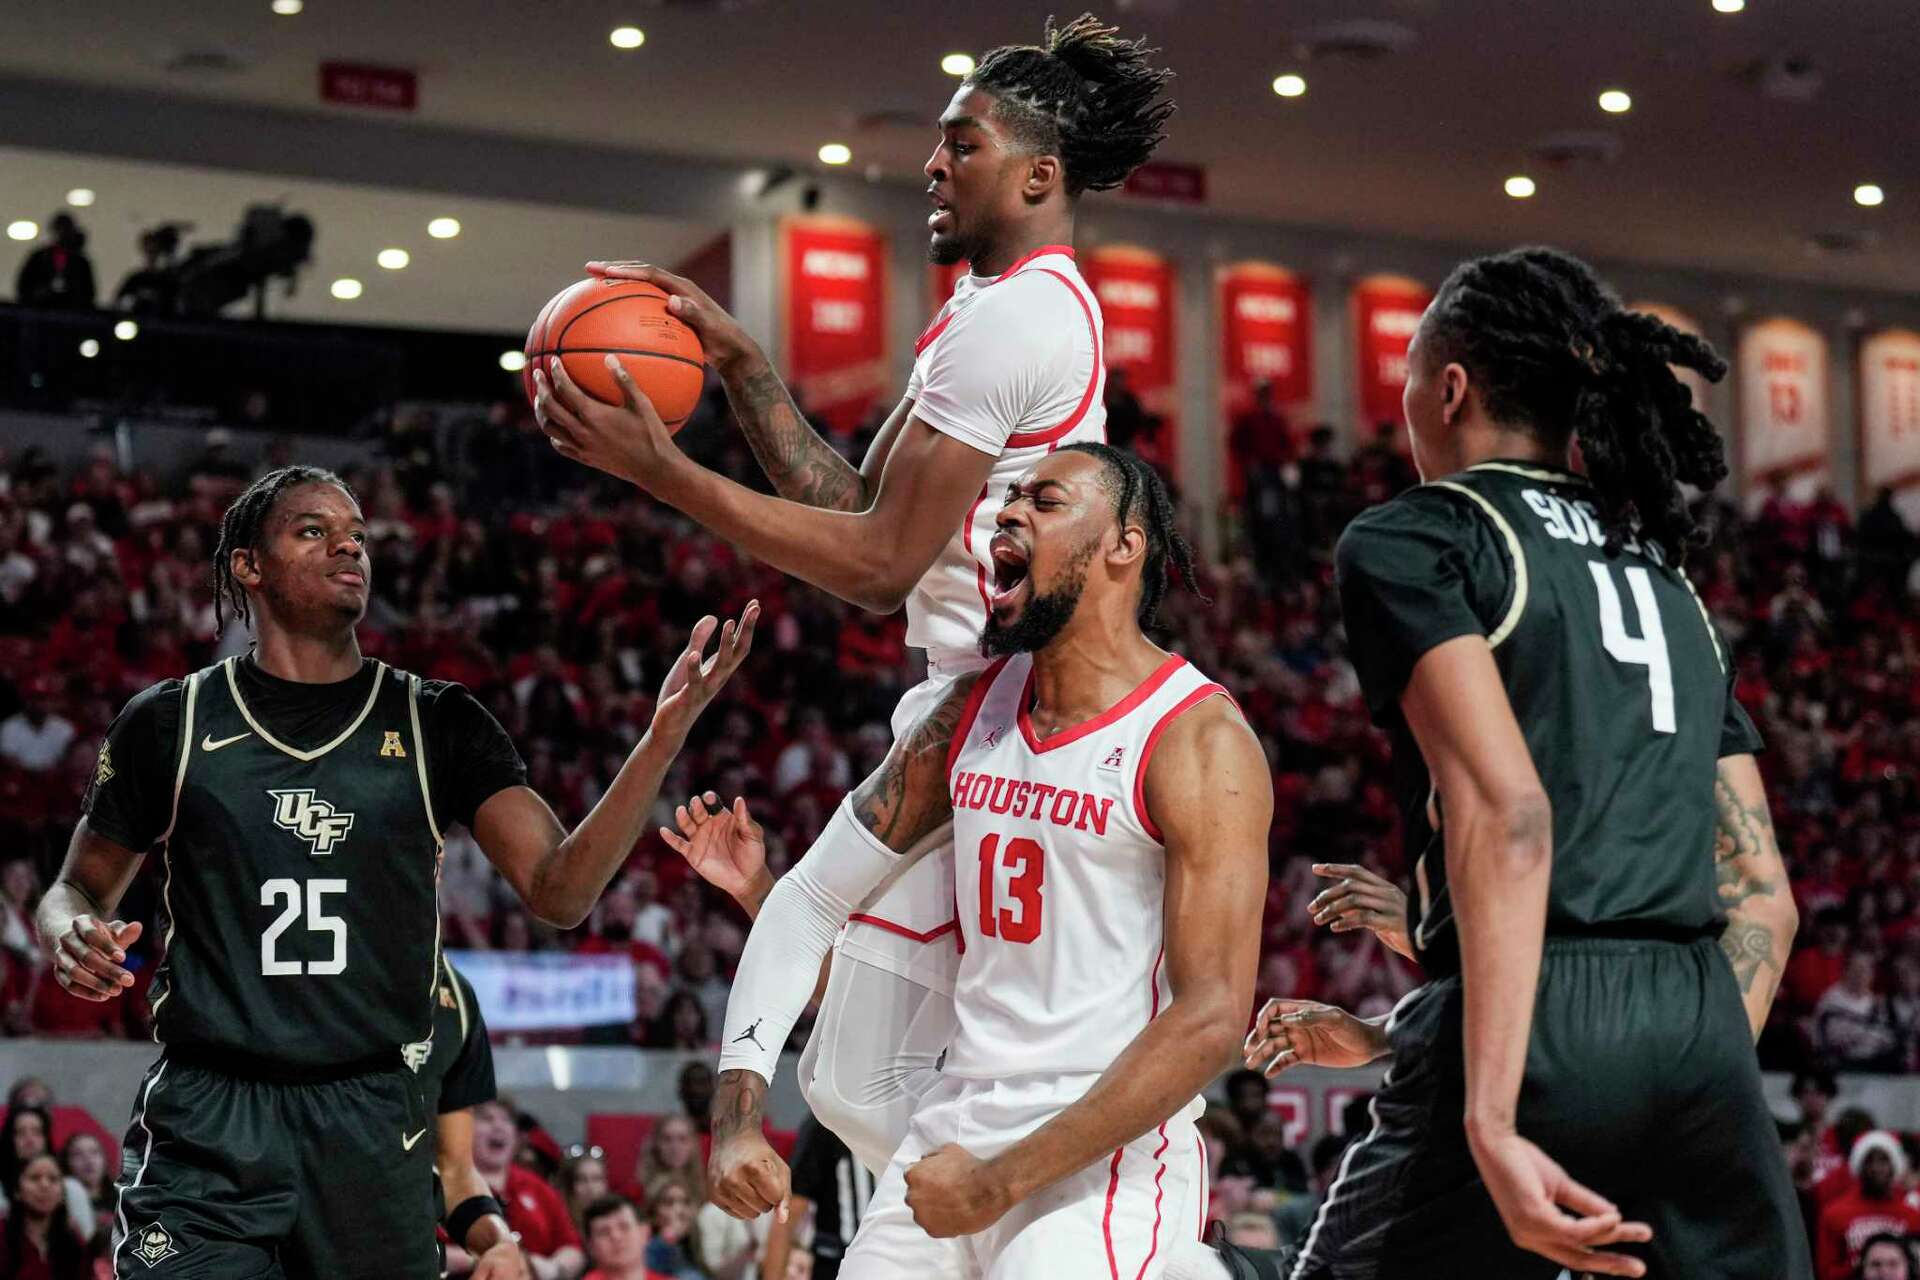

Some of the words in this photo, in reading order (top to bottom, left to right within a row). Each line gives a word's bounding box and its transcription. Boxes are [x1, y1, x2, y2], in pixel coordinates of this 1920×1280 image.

[1587, 560, 1677, 733] 4
[381, 731, 406, 757] A
[267, 789, 355, 855] UCF
[952, 771, 1113, 836] HOUSTON
[260, 878, 348, 976] 25
[979, 833, 1044, 944] 13
